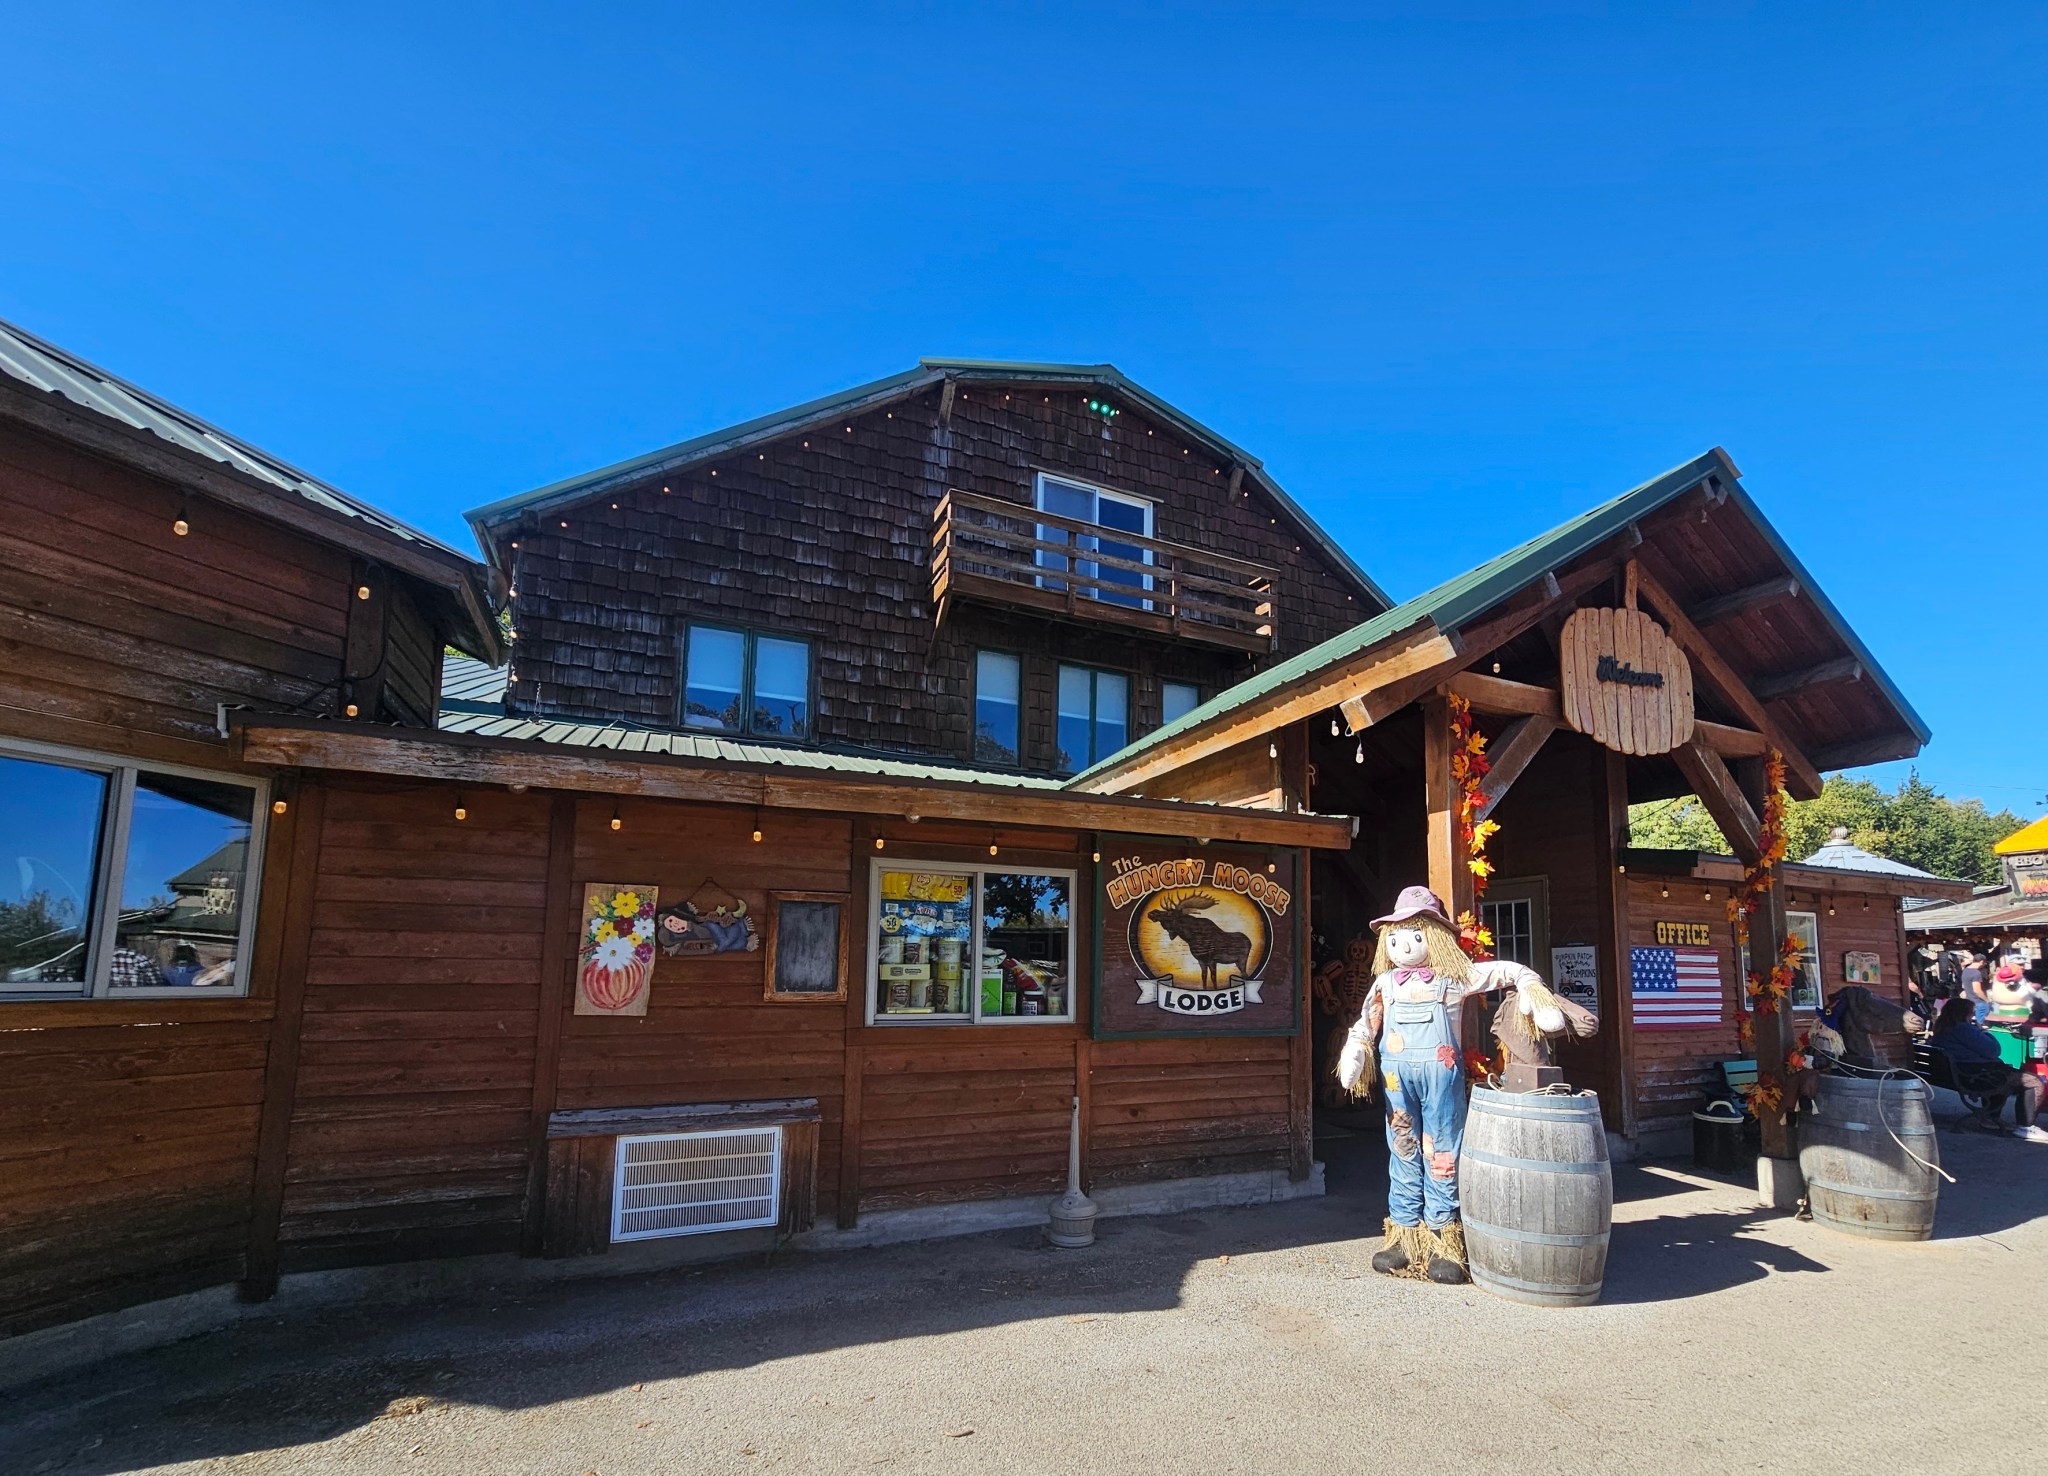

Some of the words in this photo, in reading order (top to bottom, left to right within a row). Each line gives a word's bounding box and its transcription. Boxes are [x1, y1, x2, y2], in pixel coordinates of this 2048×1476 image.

[1111, 855, 1142, 875] The
[2015, 855, 2043, 866] BBQ
[1106, 859, 1205, 909] HUNGRY
[1213, 862, 1290, 916] MOOSE
[1656, 921, 1710, 945] OFFICE
[1577, 952, 1593, 960] PATCH
[1570, 969, 1596, 978] PUMPKINS
[1164, 990, 1242, 1011] LODGE
